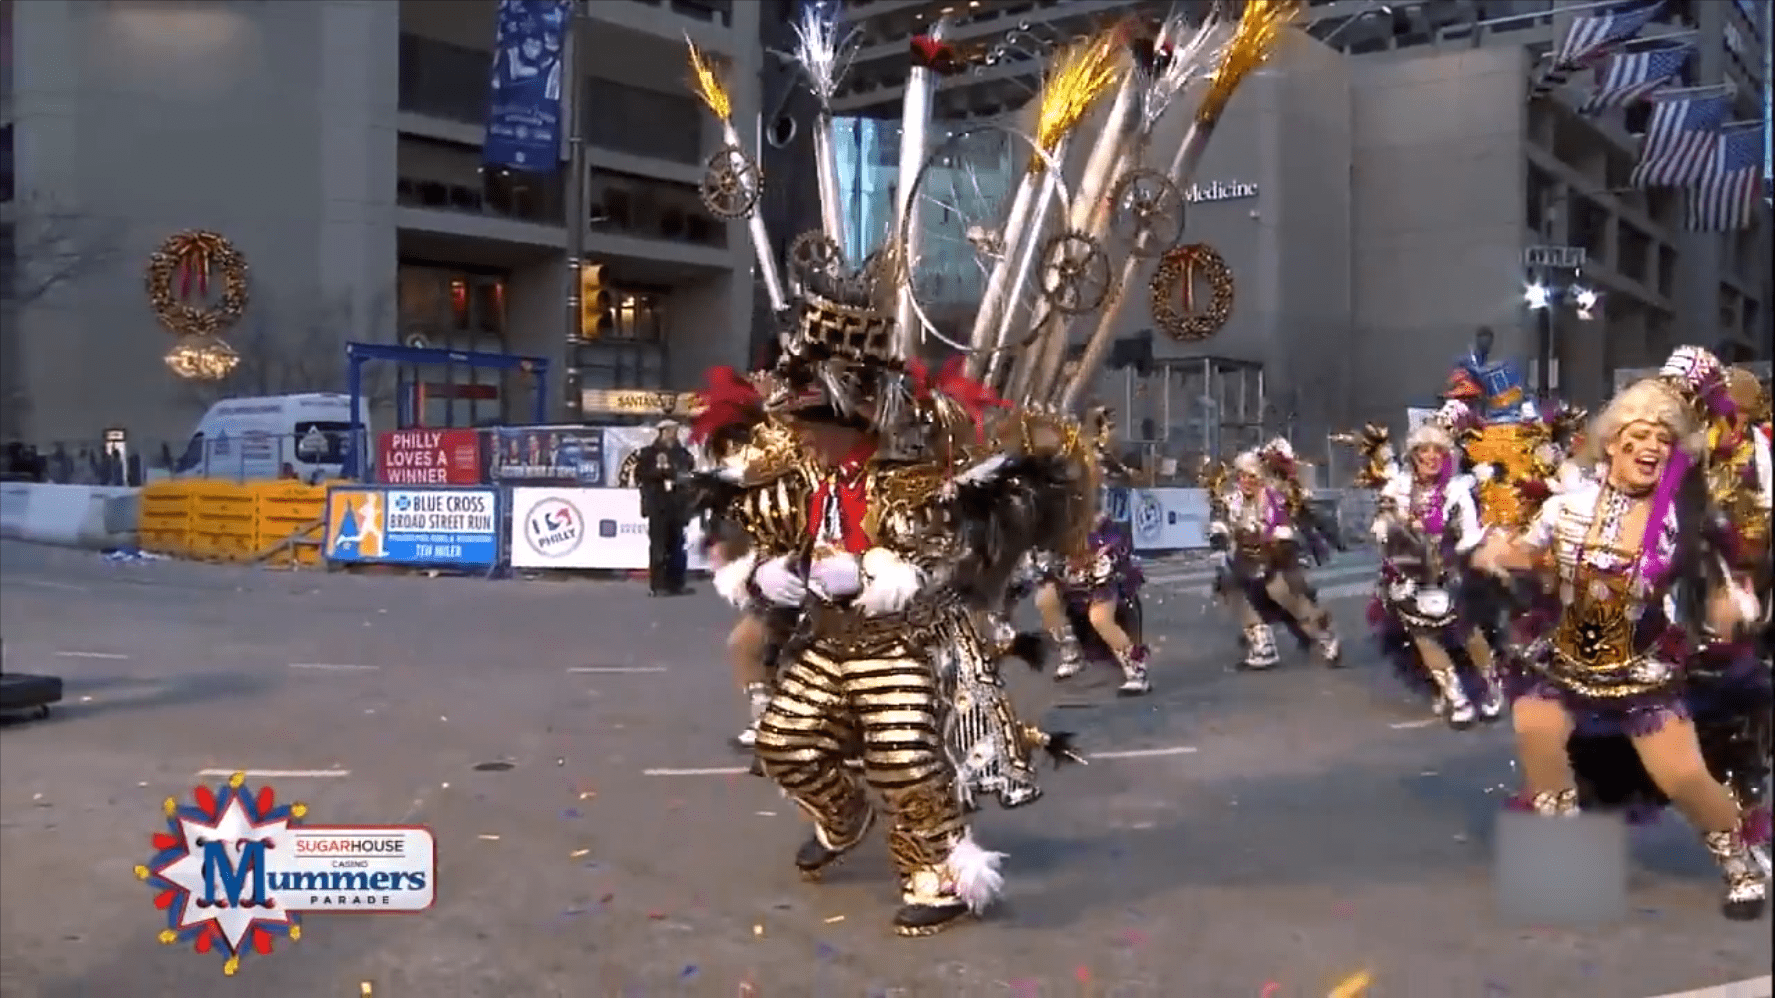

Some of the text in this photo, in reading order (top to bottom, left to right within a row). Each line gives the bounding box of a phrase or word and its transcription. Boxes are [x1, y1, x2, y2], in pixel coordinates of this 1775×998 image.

[392, 432, 443, 450] PHILLY
[385, 451, 433, 467] LOVES
[436, 450, 449, 467] A
[386, 468, 448, 484] WINNER
[413, 495, 485, 513] BLUE CROSS
[389, 514, 491, 530] BROAD STREET RUN
[537, 527, 577, 549] PHILLY
